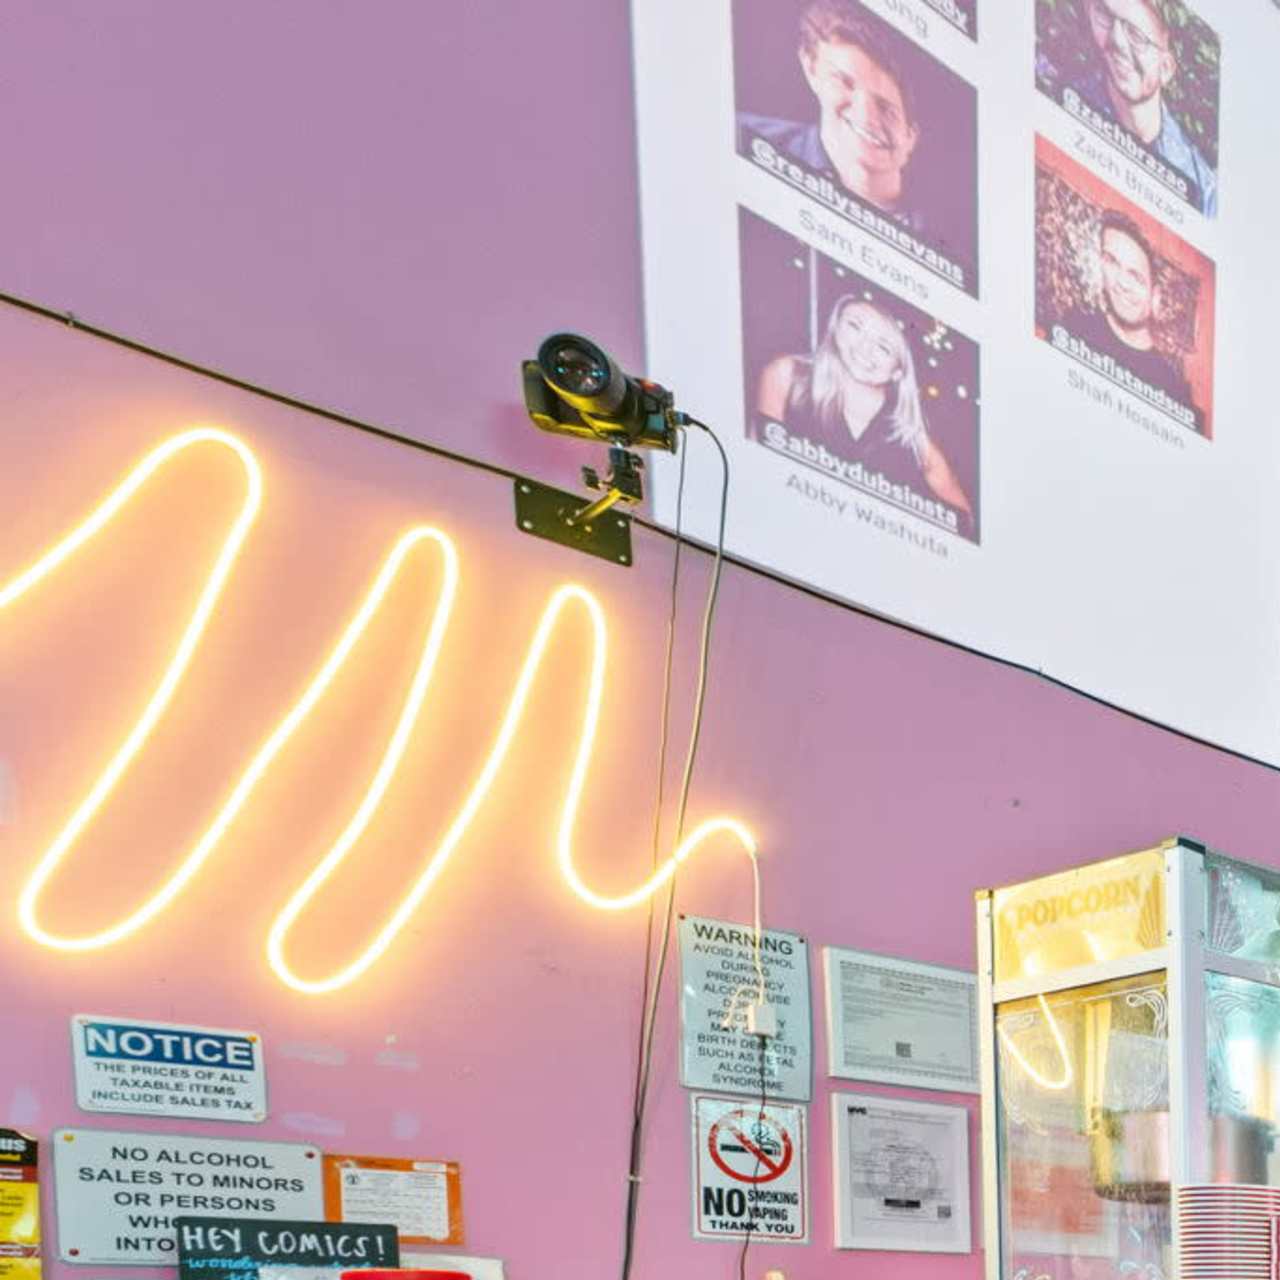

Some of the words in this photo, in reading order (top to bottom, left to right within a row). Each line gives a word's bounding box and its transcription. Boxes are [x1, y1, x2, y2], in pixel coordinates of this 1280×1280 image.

[799, 208, 853, 252] Sam
[861, 245, 929, 299] Evans
[786, 473, 848, 514] Abby
[1017, 878, 1141, 929] POPCORN
[693, 944, 733, 957] AVOID
[87, 1027, 253, 1066] NOTICE
[697, 1034, 737, 1046] BIRTH
[698, 1047, 734, 1059] SUCH
[738, 1051, 754, 1061] AS
[94, 1062, 126, 1072] THE
[131, 1066, 190, 1078] PRICES
[194, 1072, 216, 1080] OF
[220, 1074, 249, 1083] ALL
[712, 1073, 783, 1090] SYNDROME
[111, 1078, 184, 1091] TAXABLE
[189, 1084, 235, 1095] ITEMS
[92, 1092, 165, 1104] INCLUDE
[169, 1096, 221, 1108] SALES
[225, 1101, 253, 1110] TAX
[112, 1146, 149, 1161] NO
[157, 1150, 275, 1169] ALCOHOL
[79, 1167, 164, 1184] SALES
[171, 1172, 204, 1187] TO
[212, 1175, 304, 1192] MINORS
[114, 1192, 151, 1206] OR
[160, 1195, 276, 1212] PERSONS
[704, 1186, 746, 1217] NO
[748, 1190, 798, 1205] SMOKING
[710, 1220, 760, 1232] THANK
[766, 1223, 794, 1233] YOU
[181, 1225, 242, 1253] HEY
[258, 1230, 385, 1261] COMICS!
